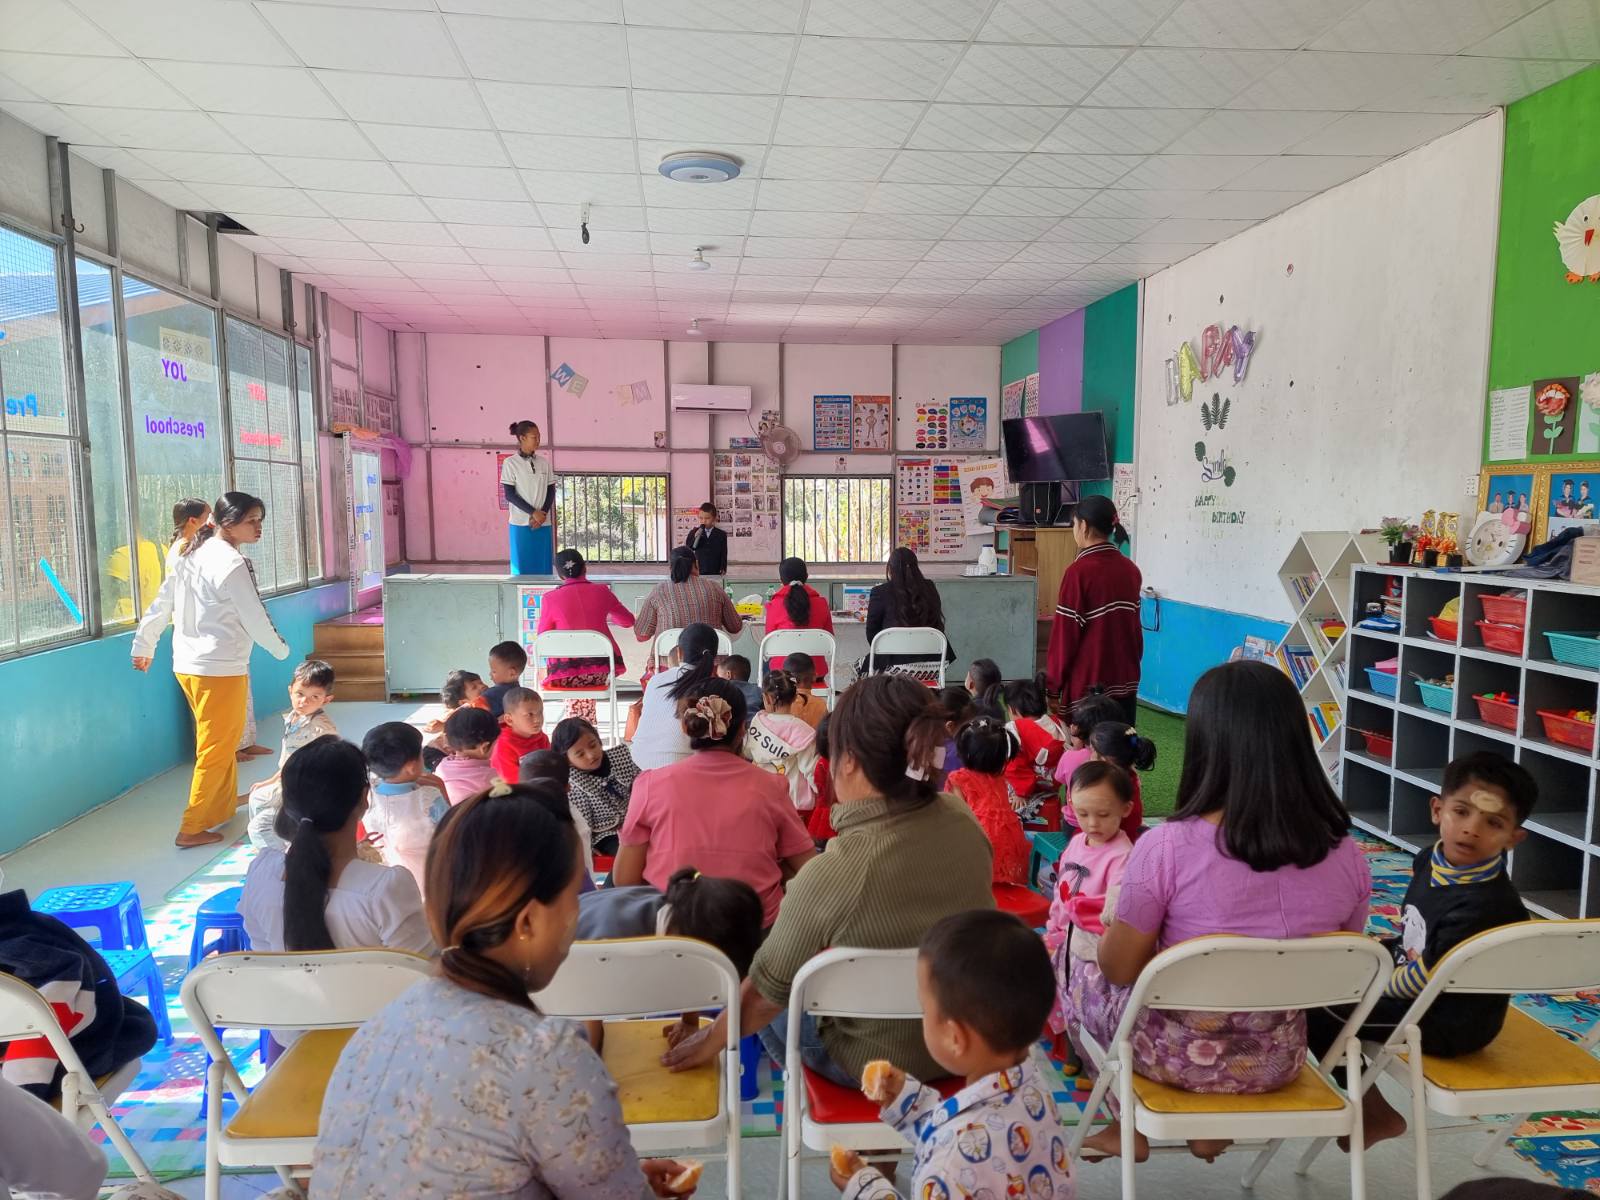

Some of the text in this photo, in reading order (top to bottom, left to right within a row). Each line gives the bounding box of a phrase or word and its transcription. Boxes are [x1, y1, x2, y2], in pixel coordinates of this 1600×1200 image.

[1194, 494, 1216, 507] HAPPY
[1212, 510, 1246, 524] BIRTHDAY
[527, 608, 536, 619] E
